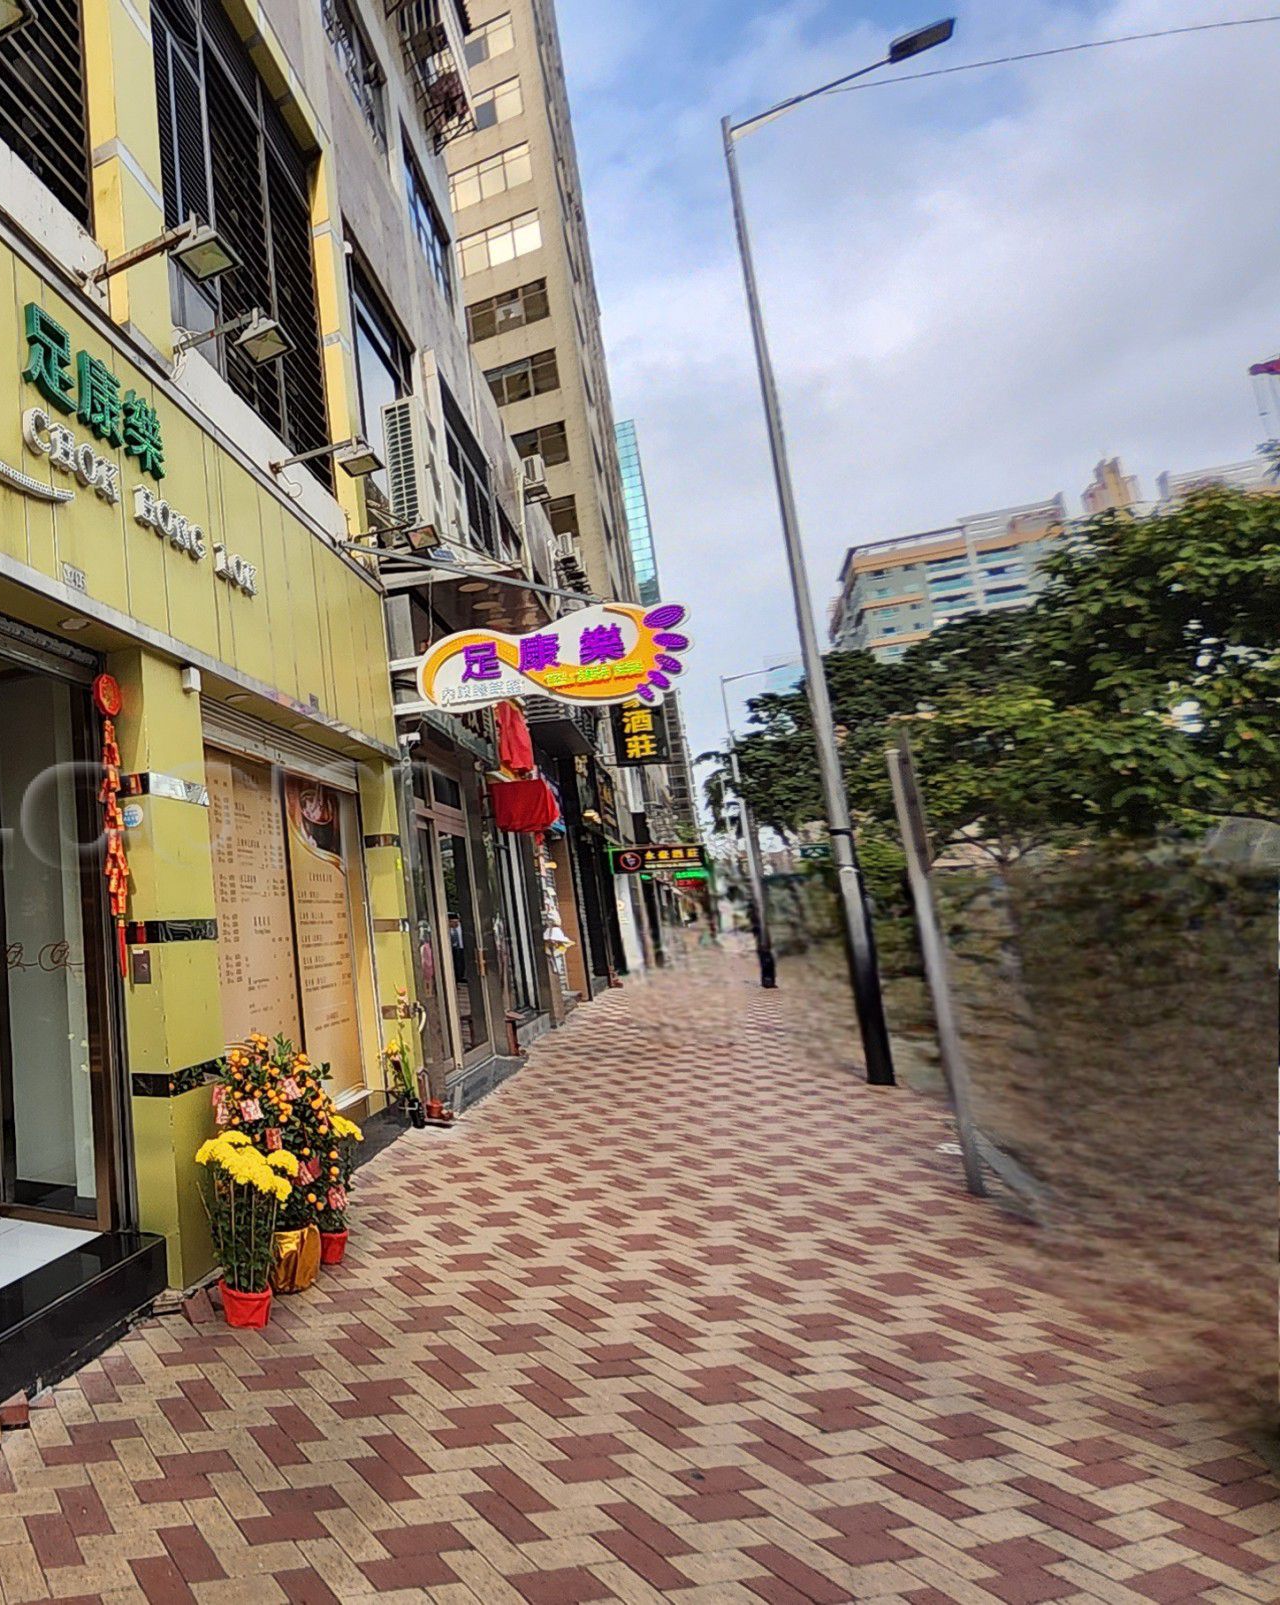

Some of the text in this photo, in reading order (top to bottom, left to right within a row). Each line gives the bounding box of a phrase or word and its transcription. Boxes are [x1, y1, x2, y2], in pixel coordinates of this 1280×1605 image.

[22, 302, 166, 481] 足康樂
[23, 407, 119, 504] CHOK
[212, 542, 259, 597] LOK
[461, 623, 625, 682] 足康樂
